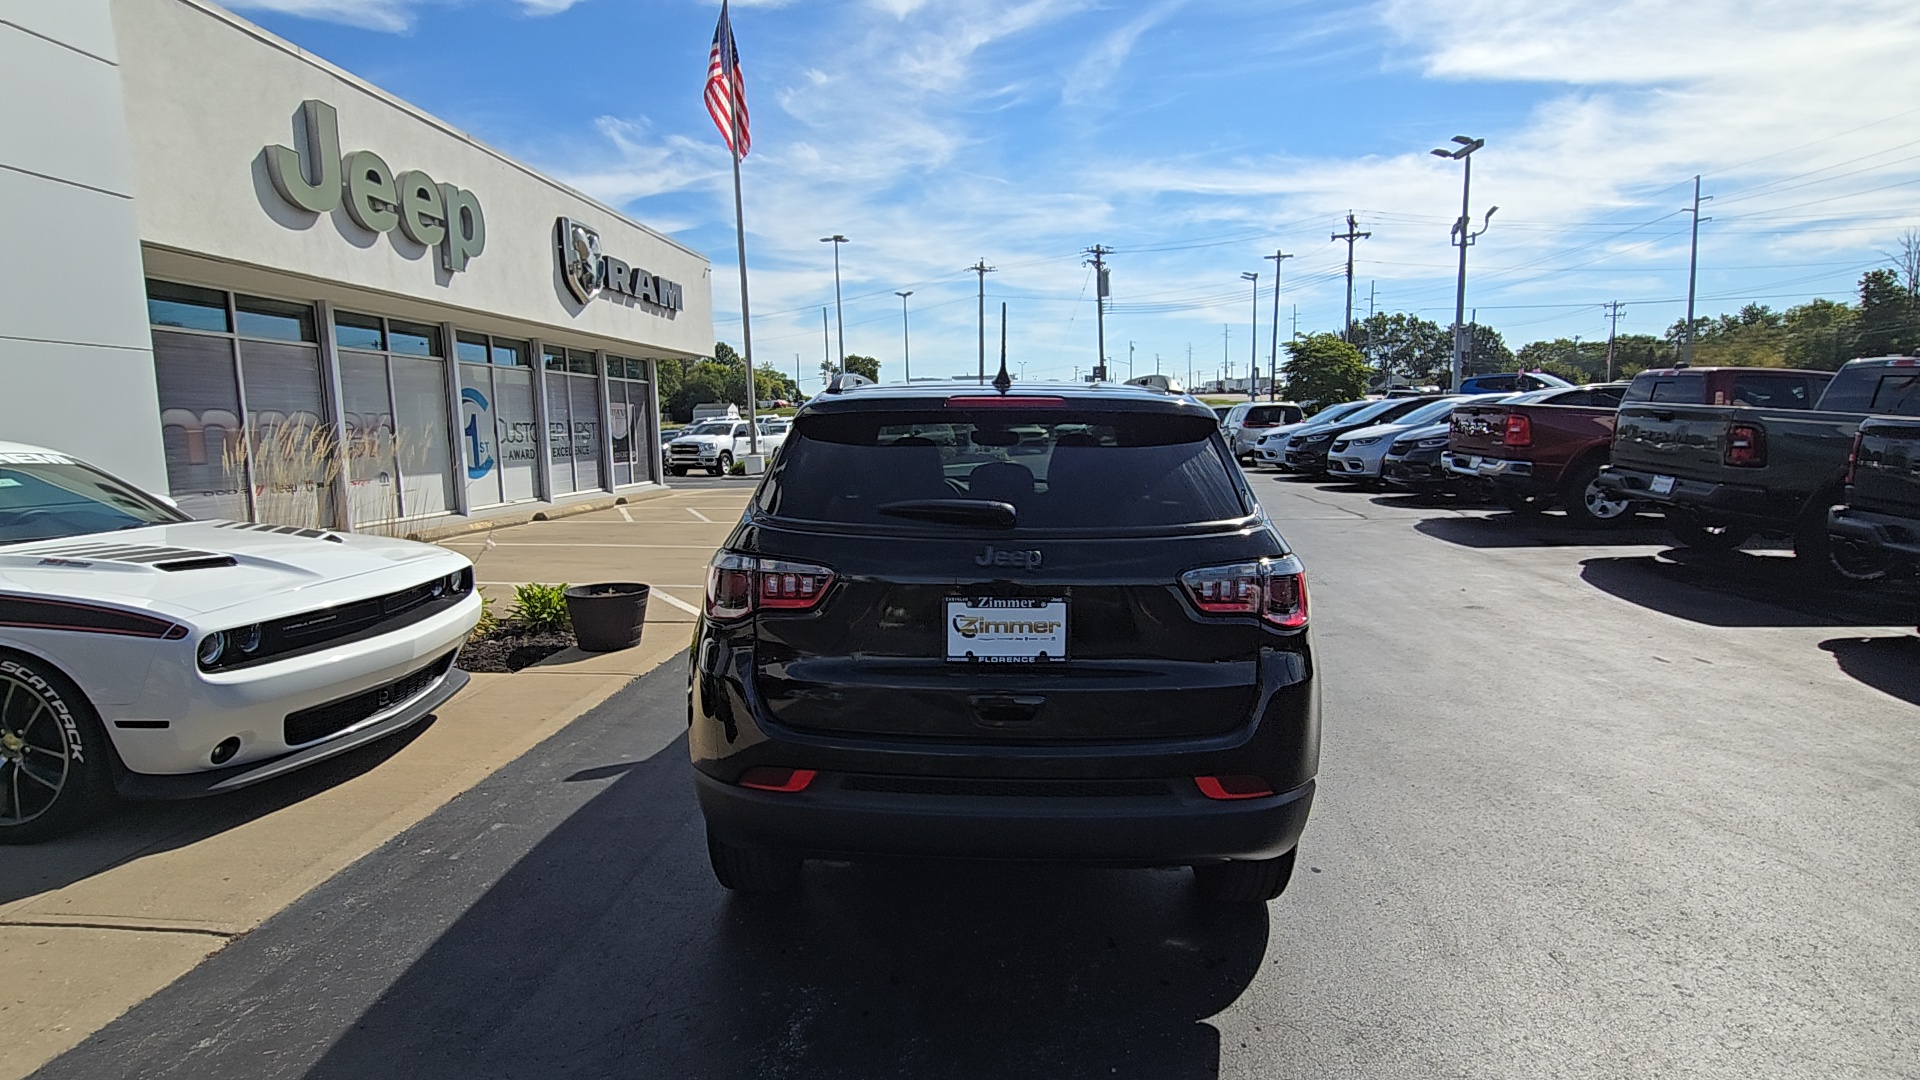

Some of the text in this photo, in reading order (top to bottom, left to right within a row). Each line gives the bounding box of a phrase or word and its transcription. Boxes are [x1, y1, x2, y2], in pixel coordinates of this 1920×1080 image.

[264, 99, 486, 273] Jeep
[602, 255, 684, 313] RAM
[508, 448, 537, 461] AWARD
[975, 545, 1043, 572] Jeep
[978, 596, 1036, 608] Zimmer
[957, 615, 1062, 635] Zimmer
